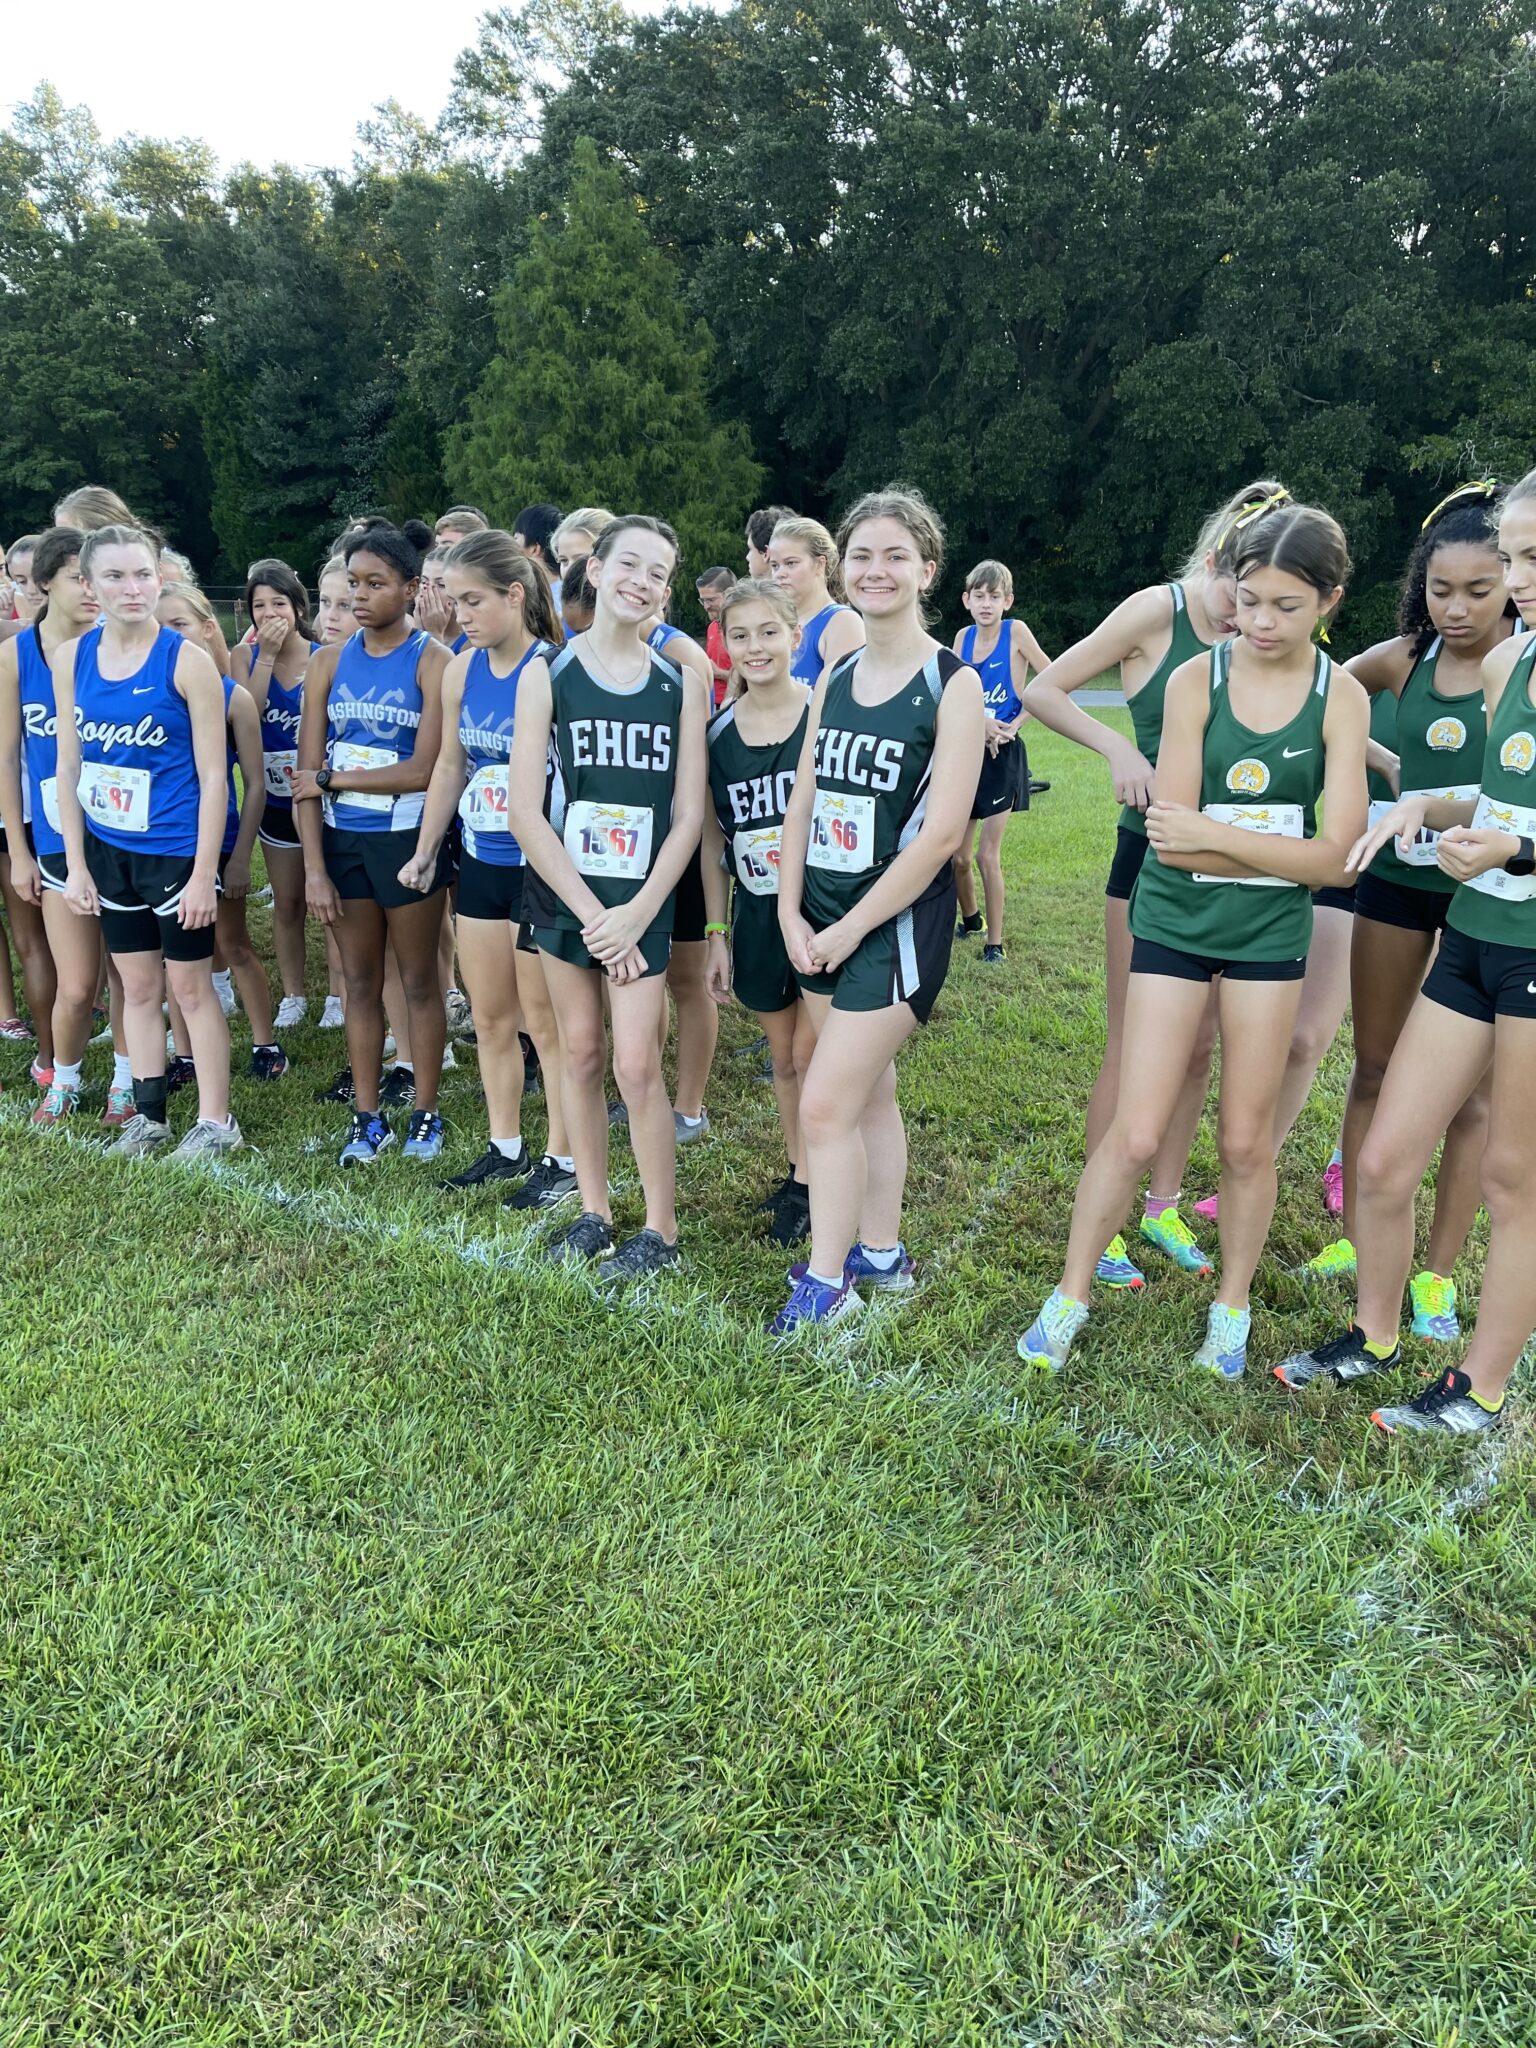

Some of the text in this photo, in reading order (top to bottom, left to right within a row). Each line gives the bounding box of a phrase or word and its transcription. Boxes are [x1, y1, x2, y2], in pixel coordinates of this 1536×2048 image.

[327, 701, 421, 729] ASHINGTON
[569, 719, 671, 772] EHCS
[89, 784, 134, 813] 1587
[727, 769, 796, 823] EHC
[579, 825, 639, 857] 1567
[813, 815, 858, 851] 1566
